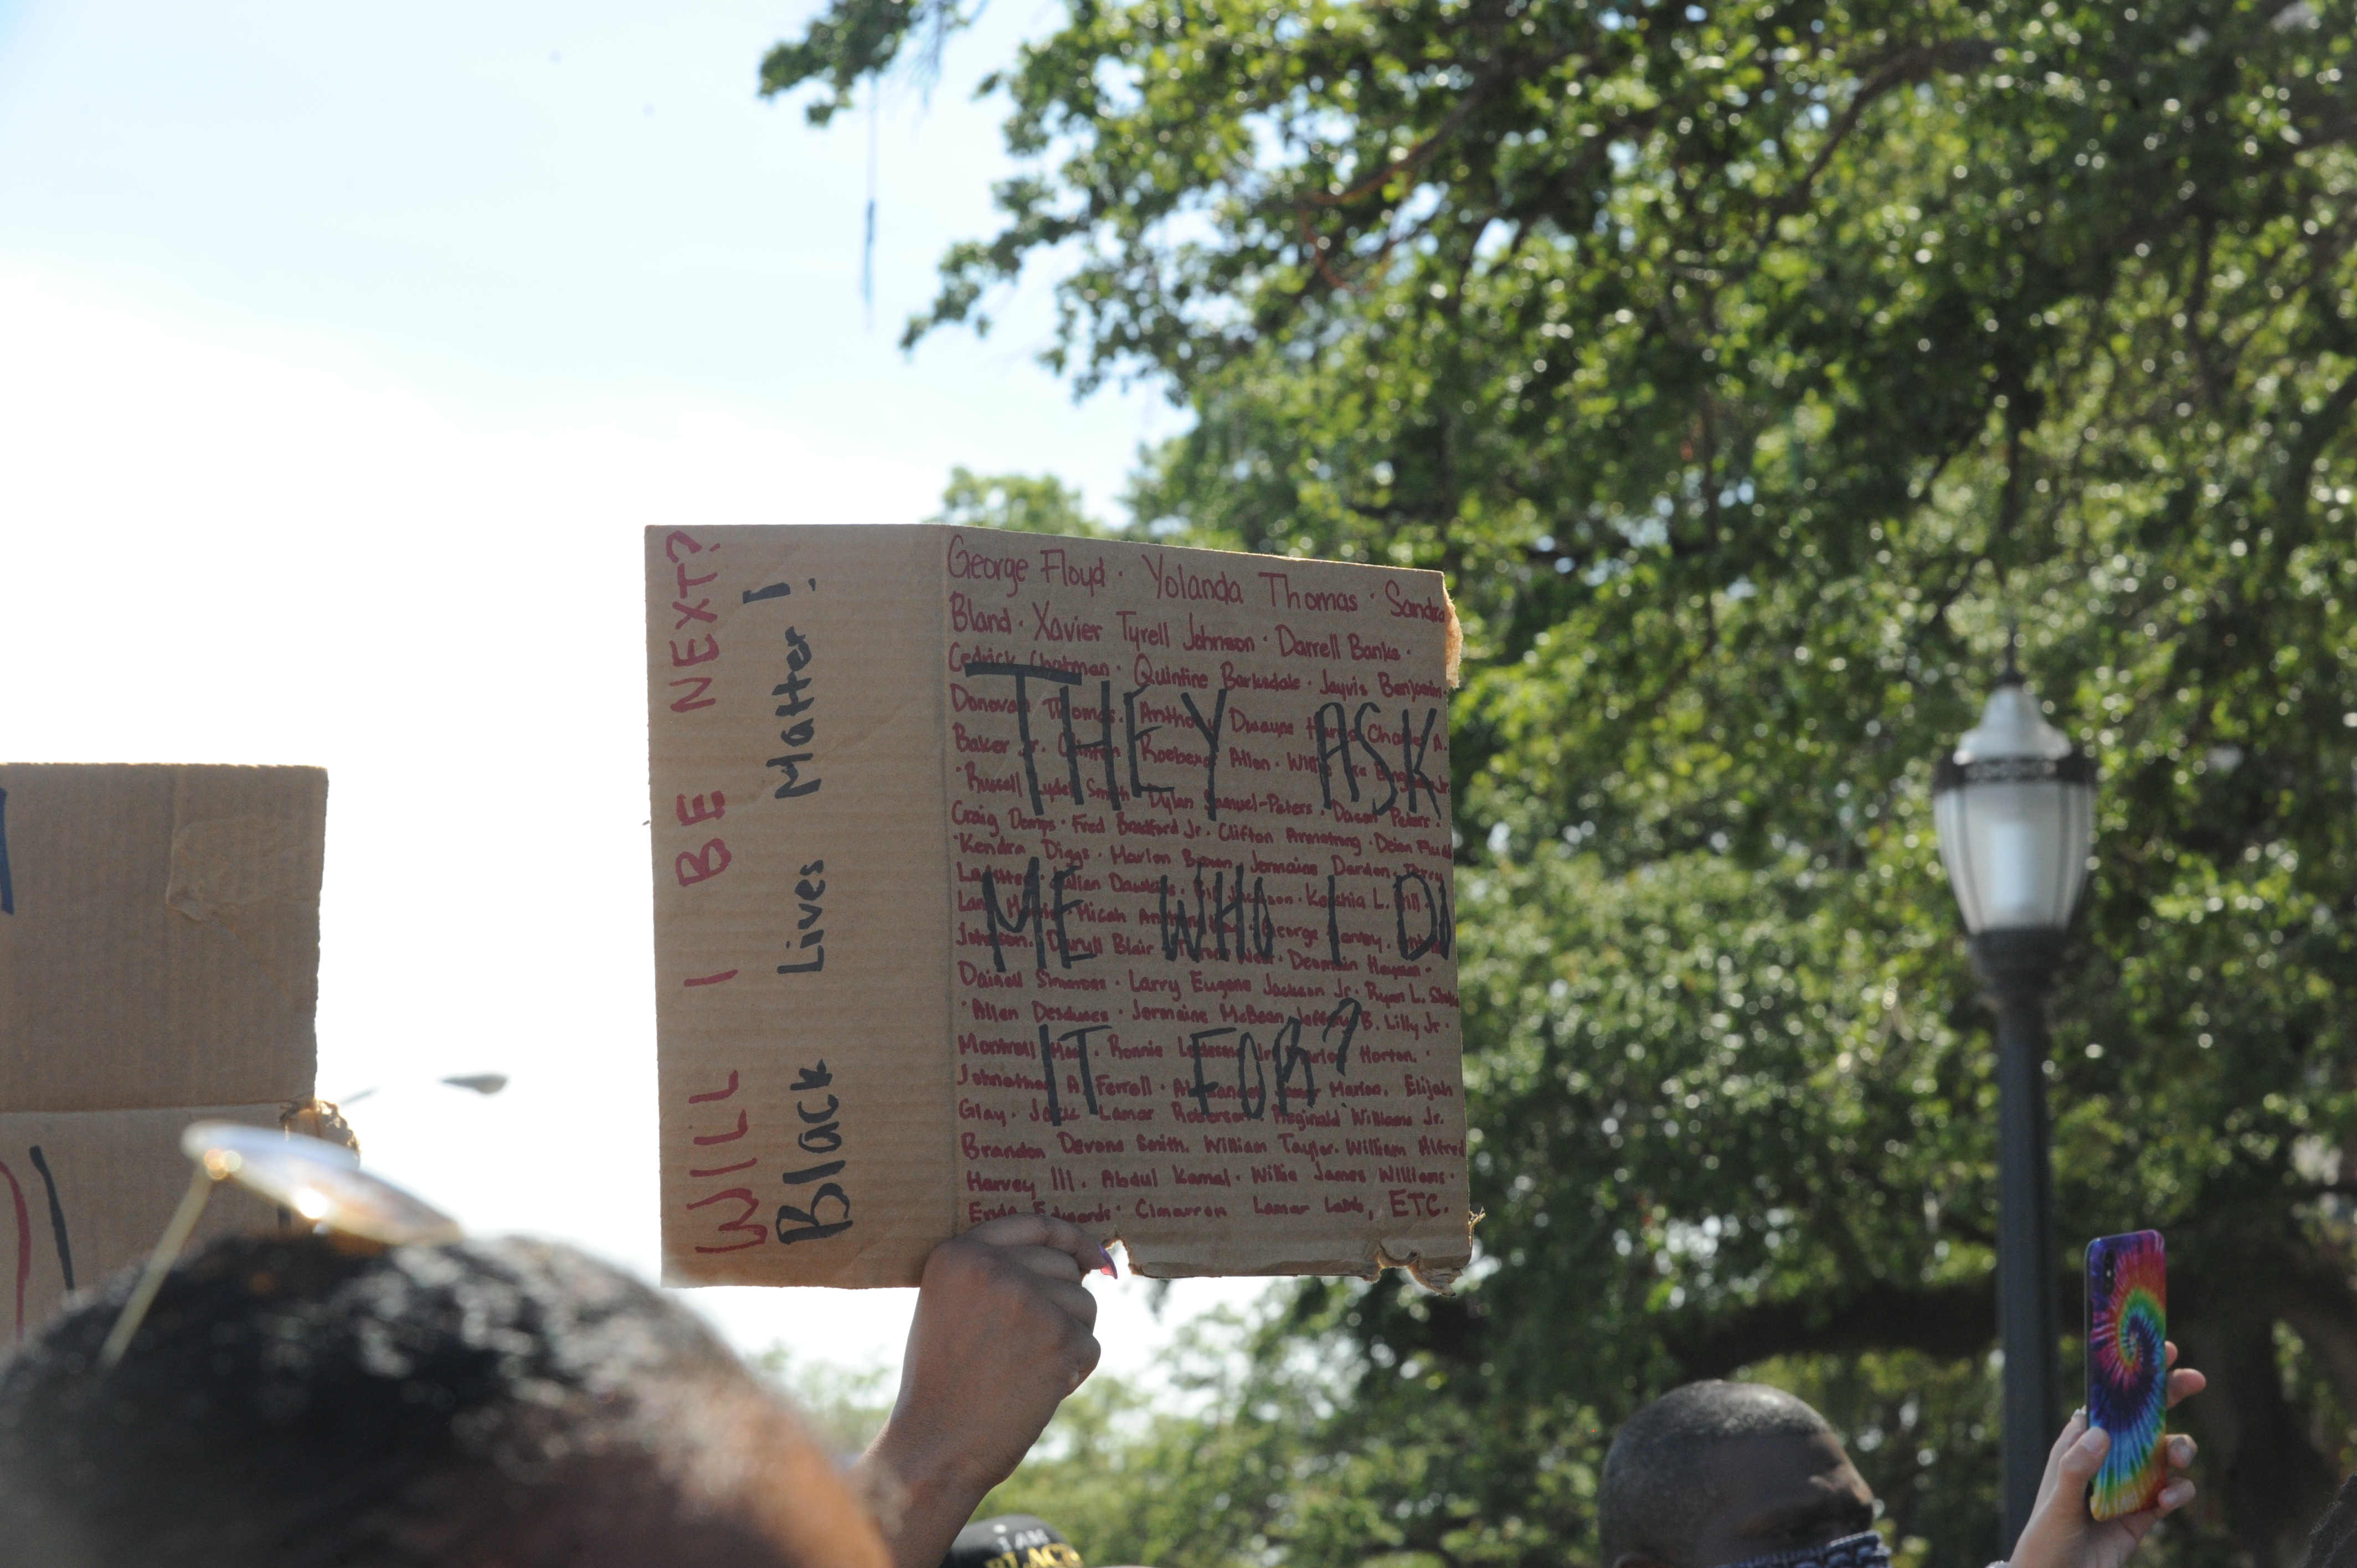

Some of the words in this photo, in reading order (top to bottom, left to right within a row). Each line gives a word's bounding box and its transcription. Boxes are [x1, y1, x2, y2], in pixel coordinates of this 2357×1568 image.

[948, 534, 1029, 597] George
[1041, 549, 1105, 596] Floyd
[1141, 554, 1243, 605] Yolanda
[1258, 571, 1358, 612] Thomas
[666, 530, 720, 713] NEXT?
[949, 590, 1011, 634] Bland
[1032, 600, 1103, 642] Xavier
[1116, 611, 1170, 651] Tyrell
[1183, 612, 1255, 652] Johnson
[1275, 624, 1341, 661] Darrell
[1347, 633, 1401, 662] Banks
[965, 662, 1228, 821] THEY
[1315, 702, 1441, 819] ASK
[1229, 747, 1270, 771] Allen
[675, 790, 732, 887] BE
[959, 832, 1026, 855] Kendra
[1072, 813, 1106, 834] Fred
[776, 859, 826, 974] Lives
[982, 856, 1098, 973] ME
[1159, 862, 1274, 963] WHO
[1327, 874, 1341, 967] I
[683, 968, 738, 987] I
[972, 998, 1020, 1023] Allen
[1128, 969, 1181, 1002] Larry
[1038, 1023, 1113, 1127] IT
[686, 1070, 768, 1254] WILL
[775, 1058, 853, 1245] Black
[961, 1132, 1046, 1160] Brandon
[966, 1169, 1036, 1201] Harvey
